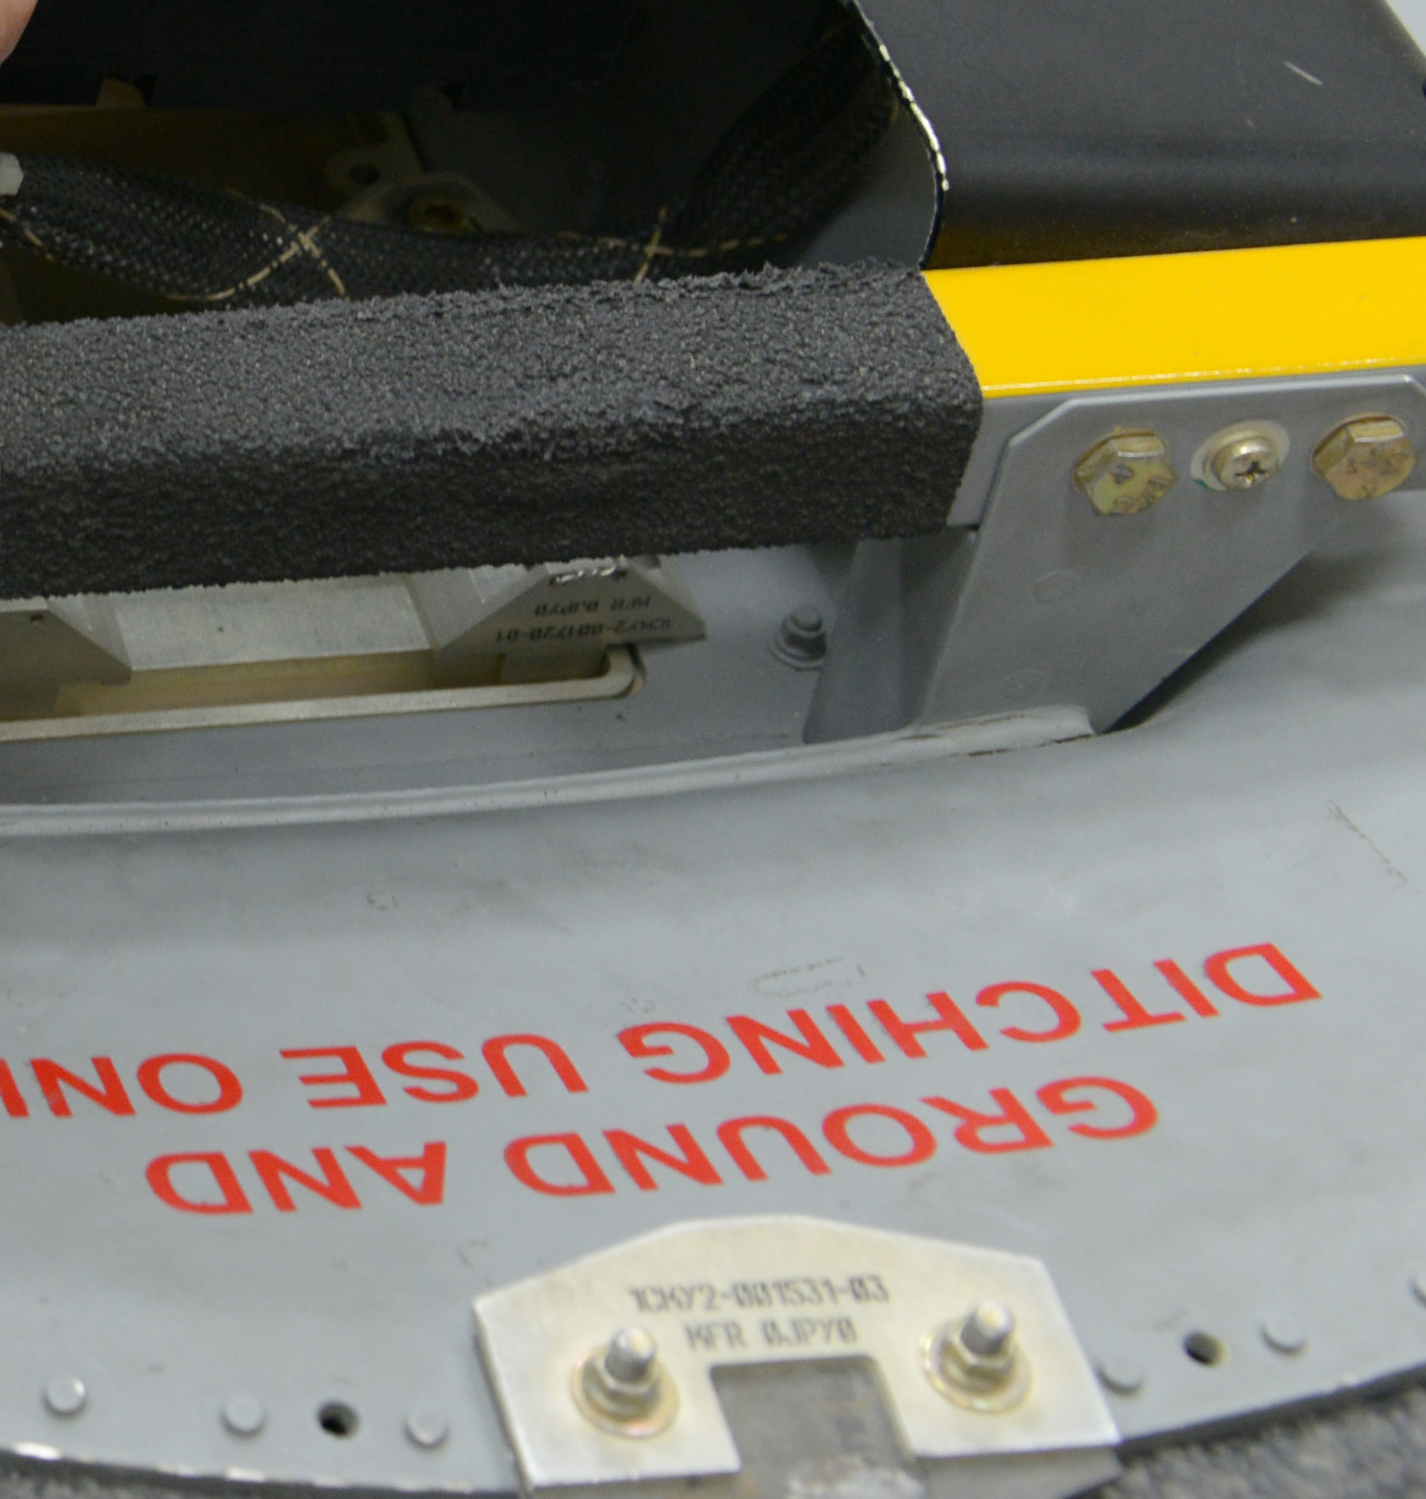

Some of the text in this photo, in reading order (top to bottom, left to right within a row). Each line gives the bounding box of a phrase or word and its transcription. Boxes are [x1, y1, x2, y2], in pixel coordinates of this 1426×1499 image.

[281, 1034, 588, 1108] USE
[618, 943, 1321, 1083] DITCHING
[146, 1077, 1157, 1214] GROUND AND
